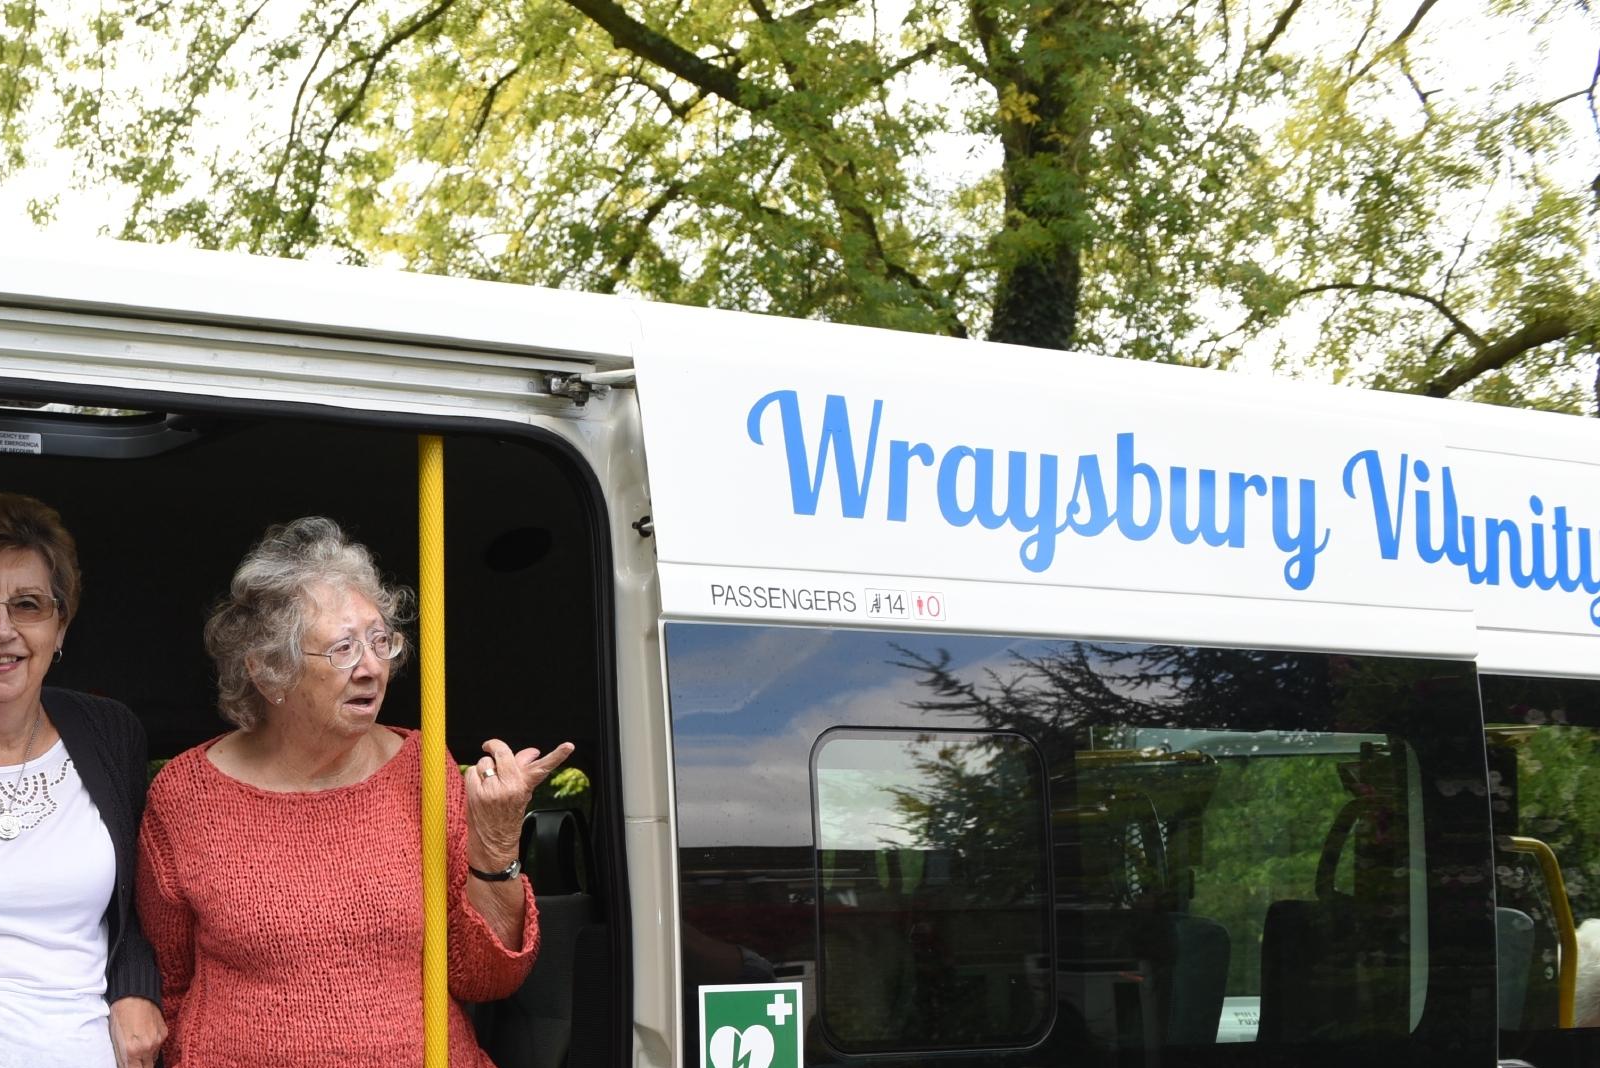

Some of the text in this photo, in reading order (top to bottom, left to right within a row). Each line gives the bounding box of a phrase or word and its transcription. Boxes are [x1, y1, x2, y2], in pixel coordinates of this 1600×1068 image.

[746, 389, 1331, 591] Wraysbury
[710, 583, 858, 613] PASSENGERS
[884, 593, 906, 615] 14
